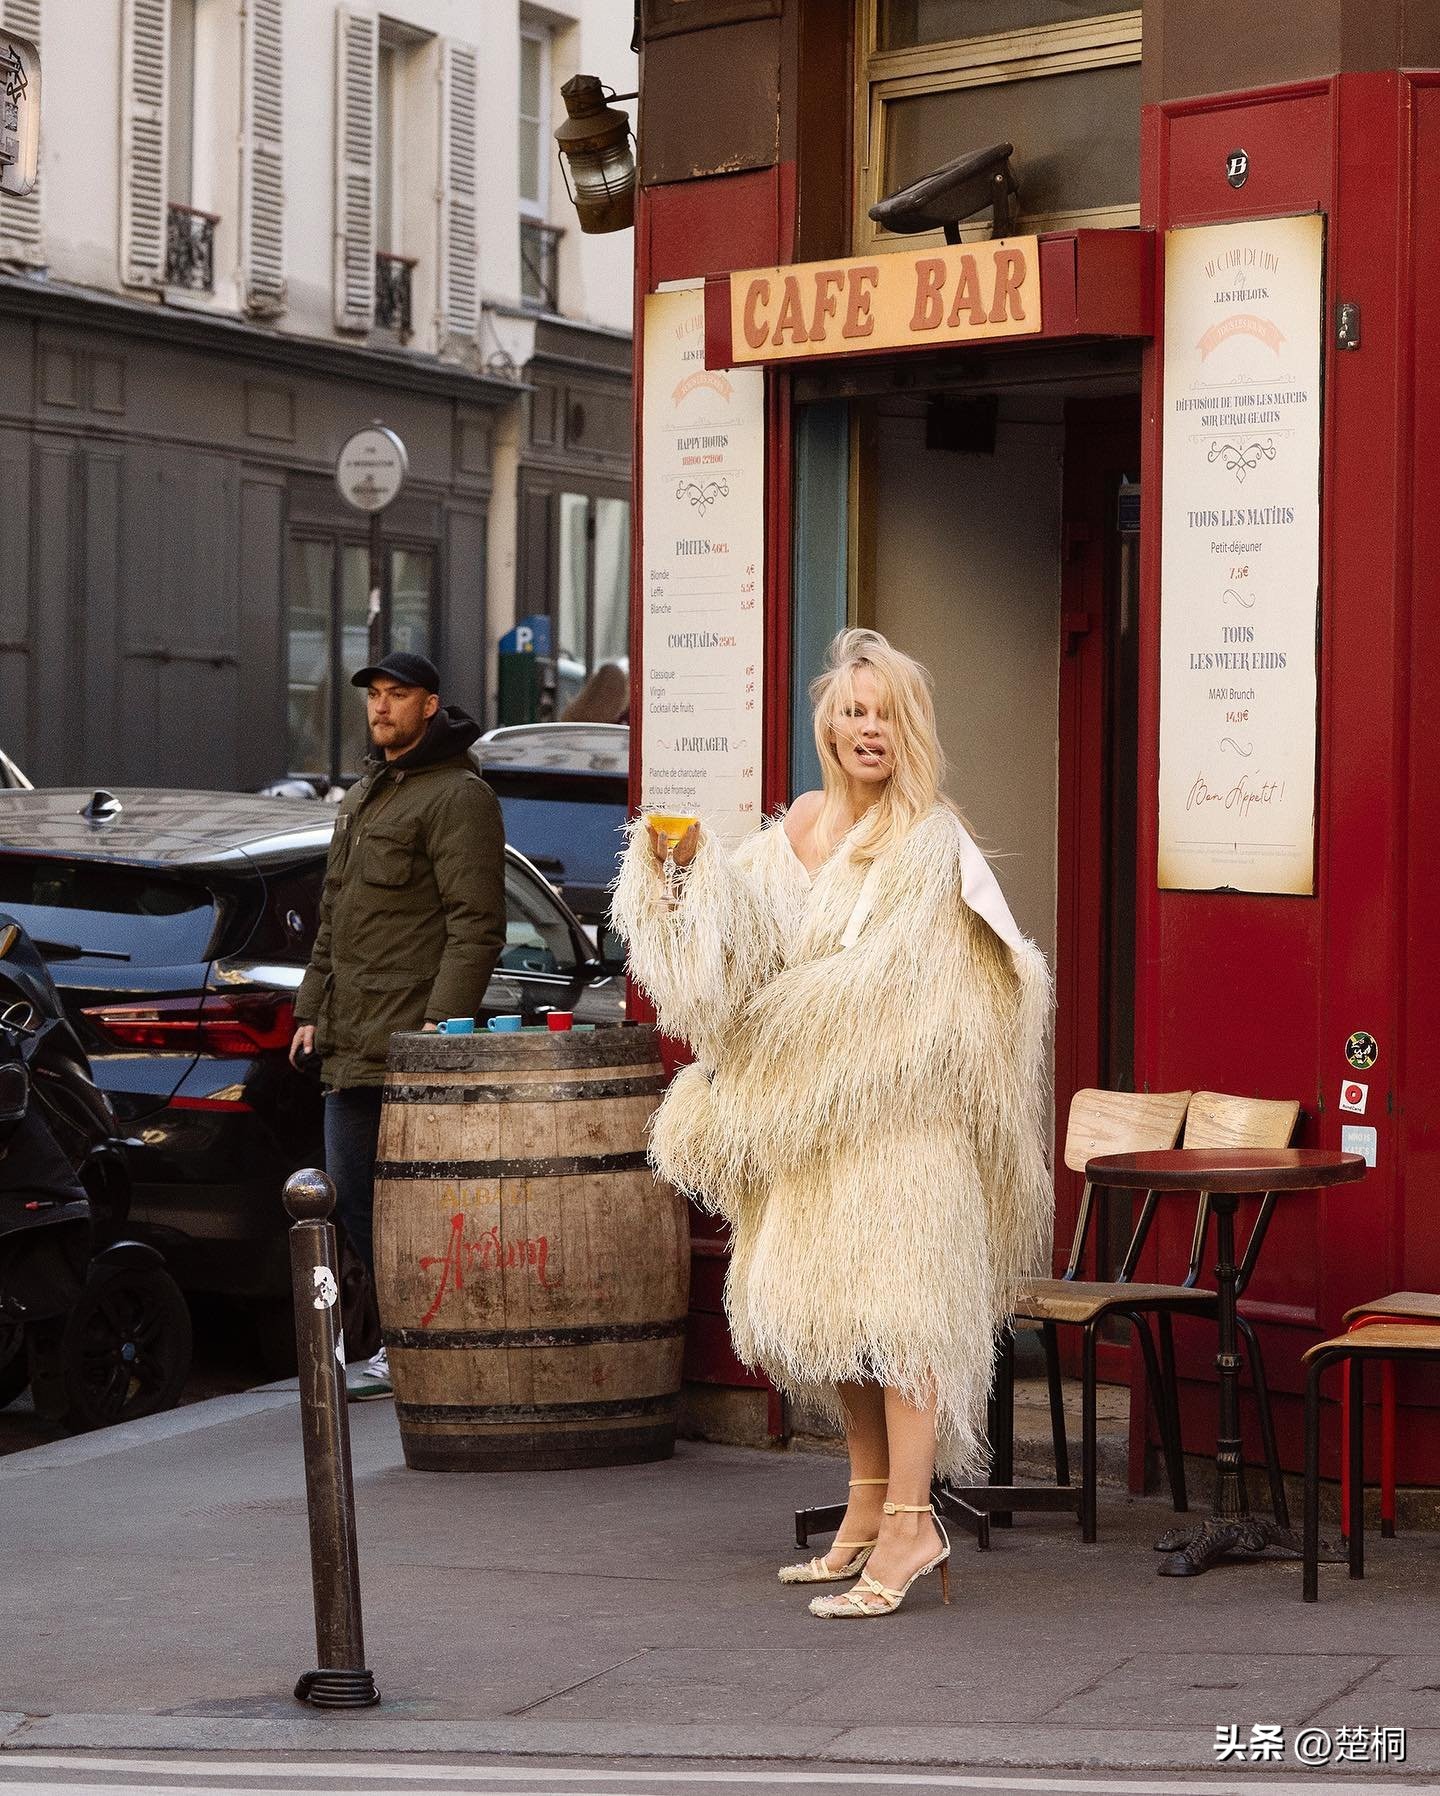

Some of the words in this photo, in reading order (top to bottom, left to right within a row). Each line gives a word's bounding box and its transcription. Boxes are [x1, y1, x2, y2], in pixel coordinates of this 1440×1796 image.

[743, 266, 879, 348] CAFE
[909, 249, 1027, 331] BAR
[1187, 511, 1219, 528] TOUS
[1221, 510, 1245, 527] LES
[1211, 541, 1262, 555] Petit-déjeuner
[650, 569, 670, 580] Blonde
[650, 604, 671, 614] Blanche
[516, 626, 533, 653] P
[1222, 626, 1254, 643] TOUS
[1190, 653, 1213, 669] LES
[1215, 652, 1249, 671] WEEK
[1251, 652, 1286, 669] ENDS
[650, 669, 676, 681] Classique
[649, 686, 666, 699] Virgin
[1208, 688, 1227, 700] MAXI
[1229, 687, 1255, 700] Brunch
[649, 702, 671, 713] Cocktail
[680, 701, 695, 713] fruits
[681, 736, 729, 752] PARTAGER
